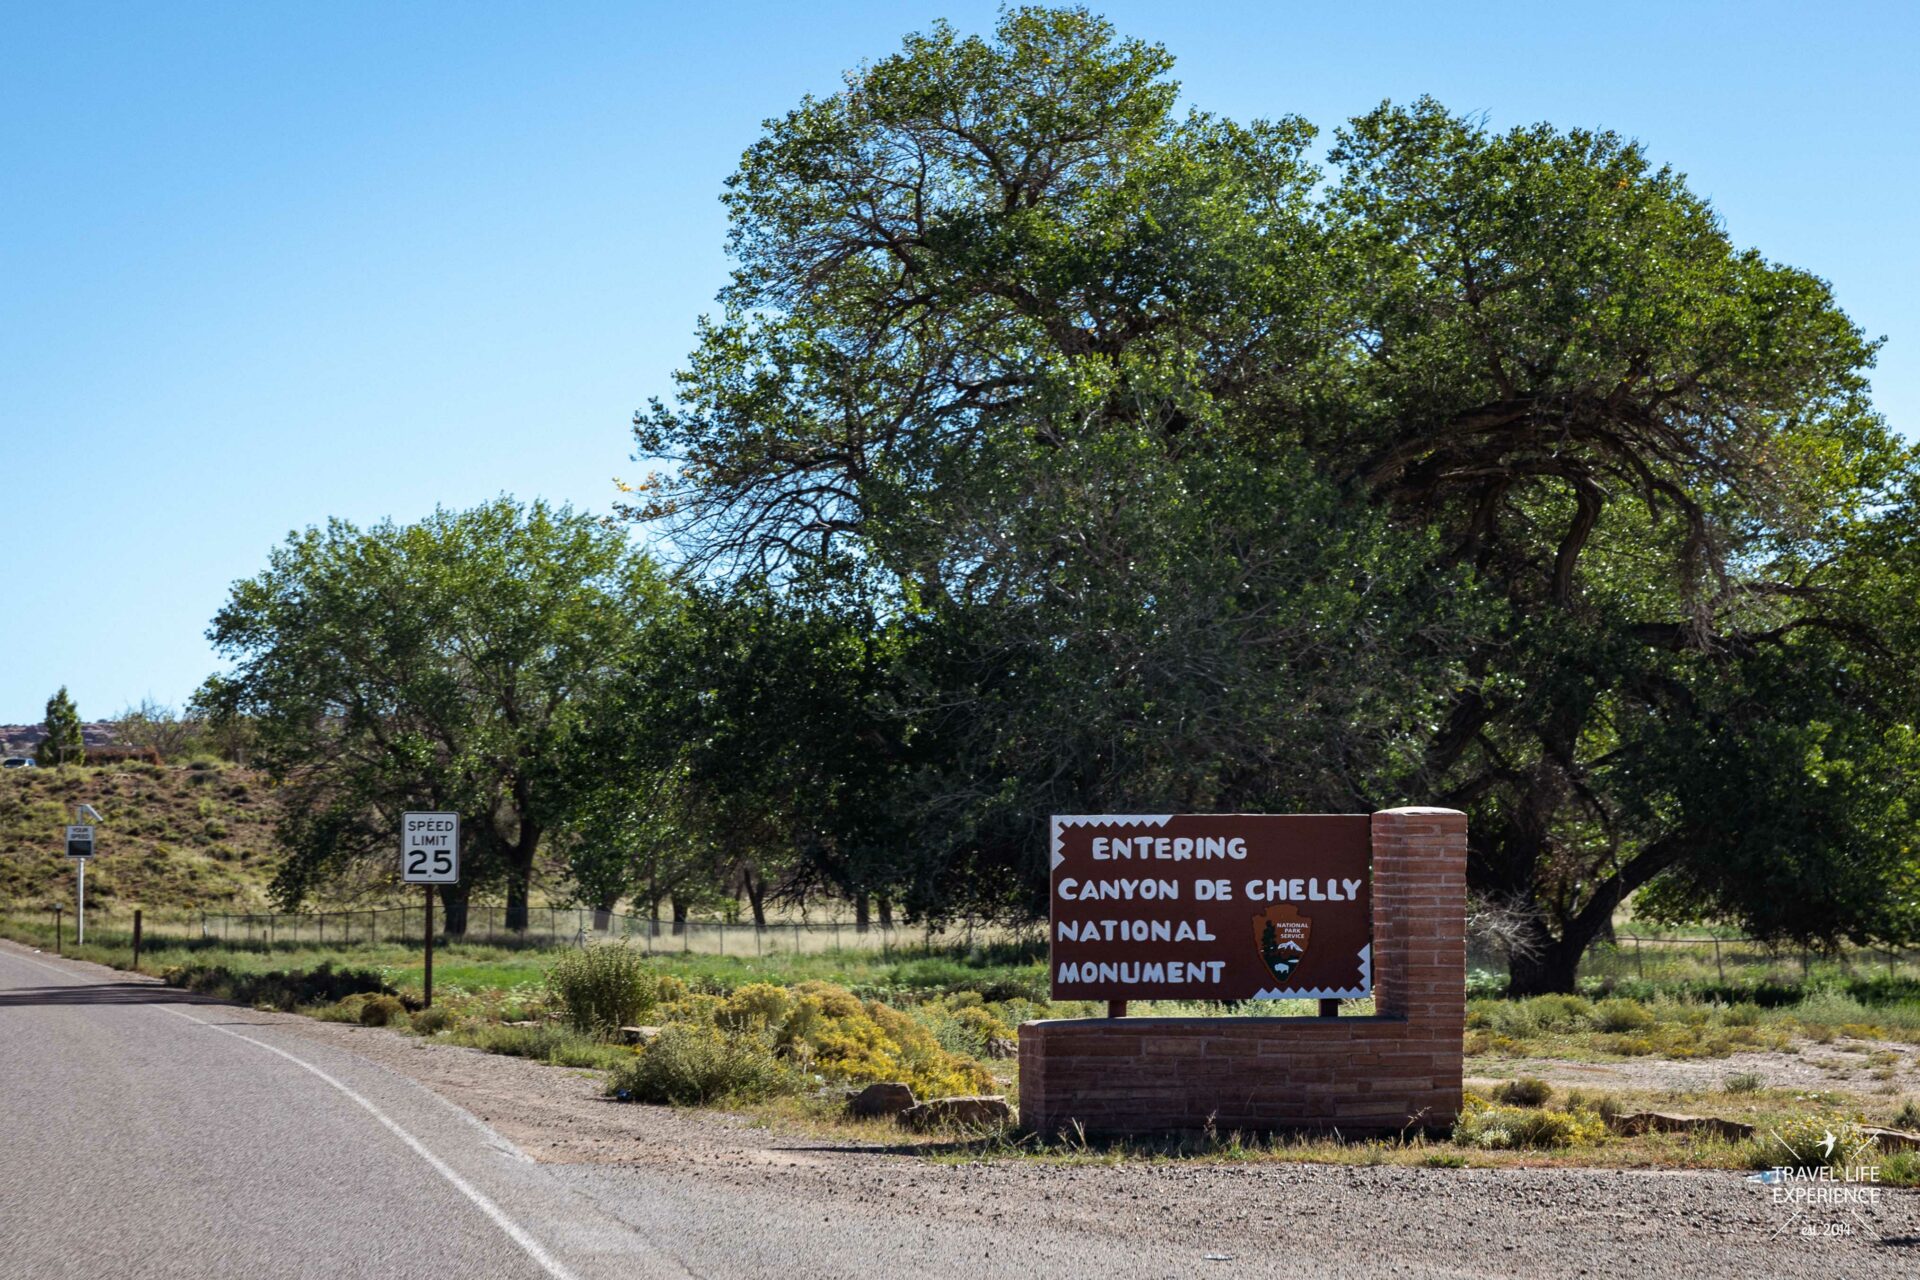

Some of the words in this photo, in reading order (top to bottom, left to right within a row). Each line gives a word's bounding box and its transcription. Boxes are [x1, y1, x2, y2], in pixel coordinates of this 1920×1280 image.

[408, 821, 454, 831] SPEED
[412, 835, 448, 846] LIMIT
[1092, 836, 1247, 861] ENTERING
[408, 849, 453, 875] 25
[1057, 877, 1179, 901] CANYON
[1195, 879, 1233, 901] DE
[1245, 877, 1362, 901] CHELLY
[1058, 919, 1216, 942] NATIONAL
[1058, 961, 1226, 984] MONUMENT
